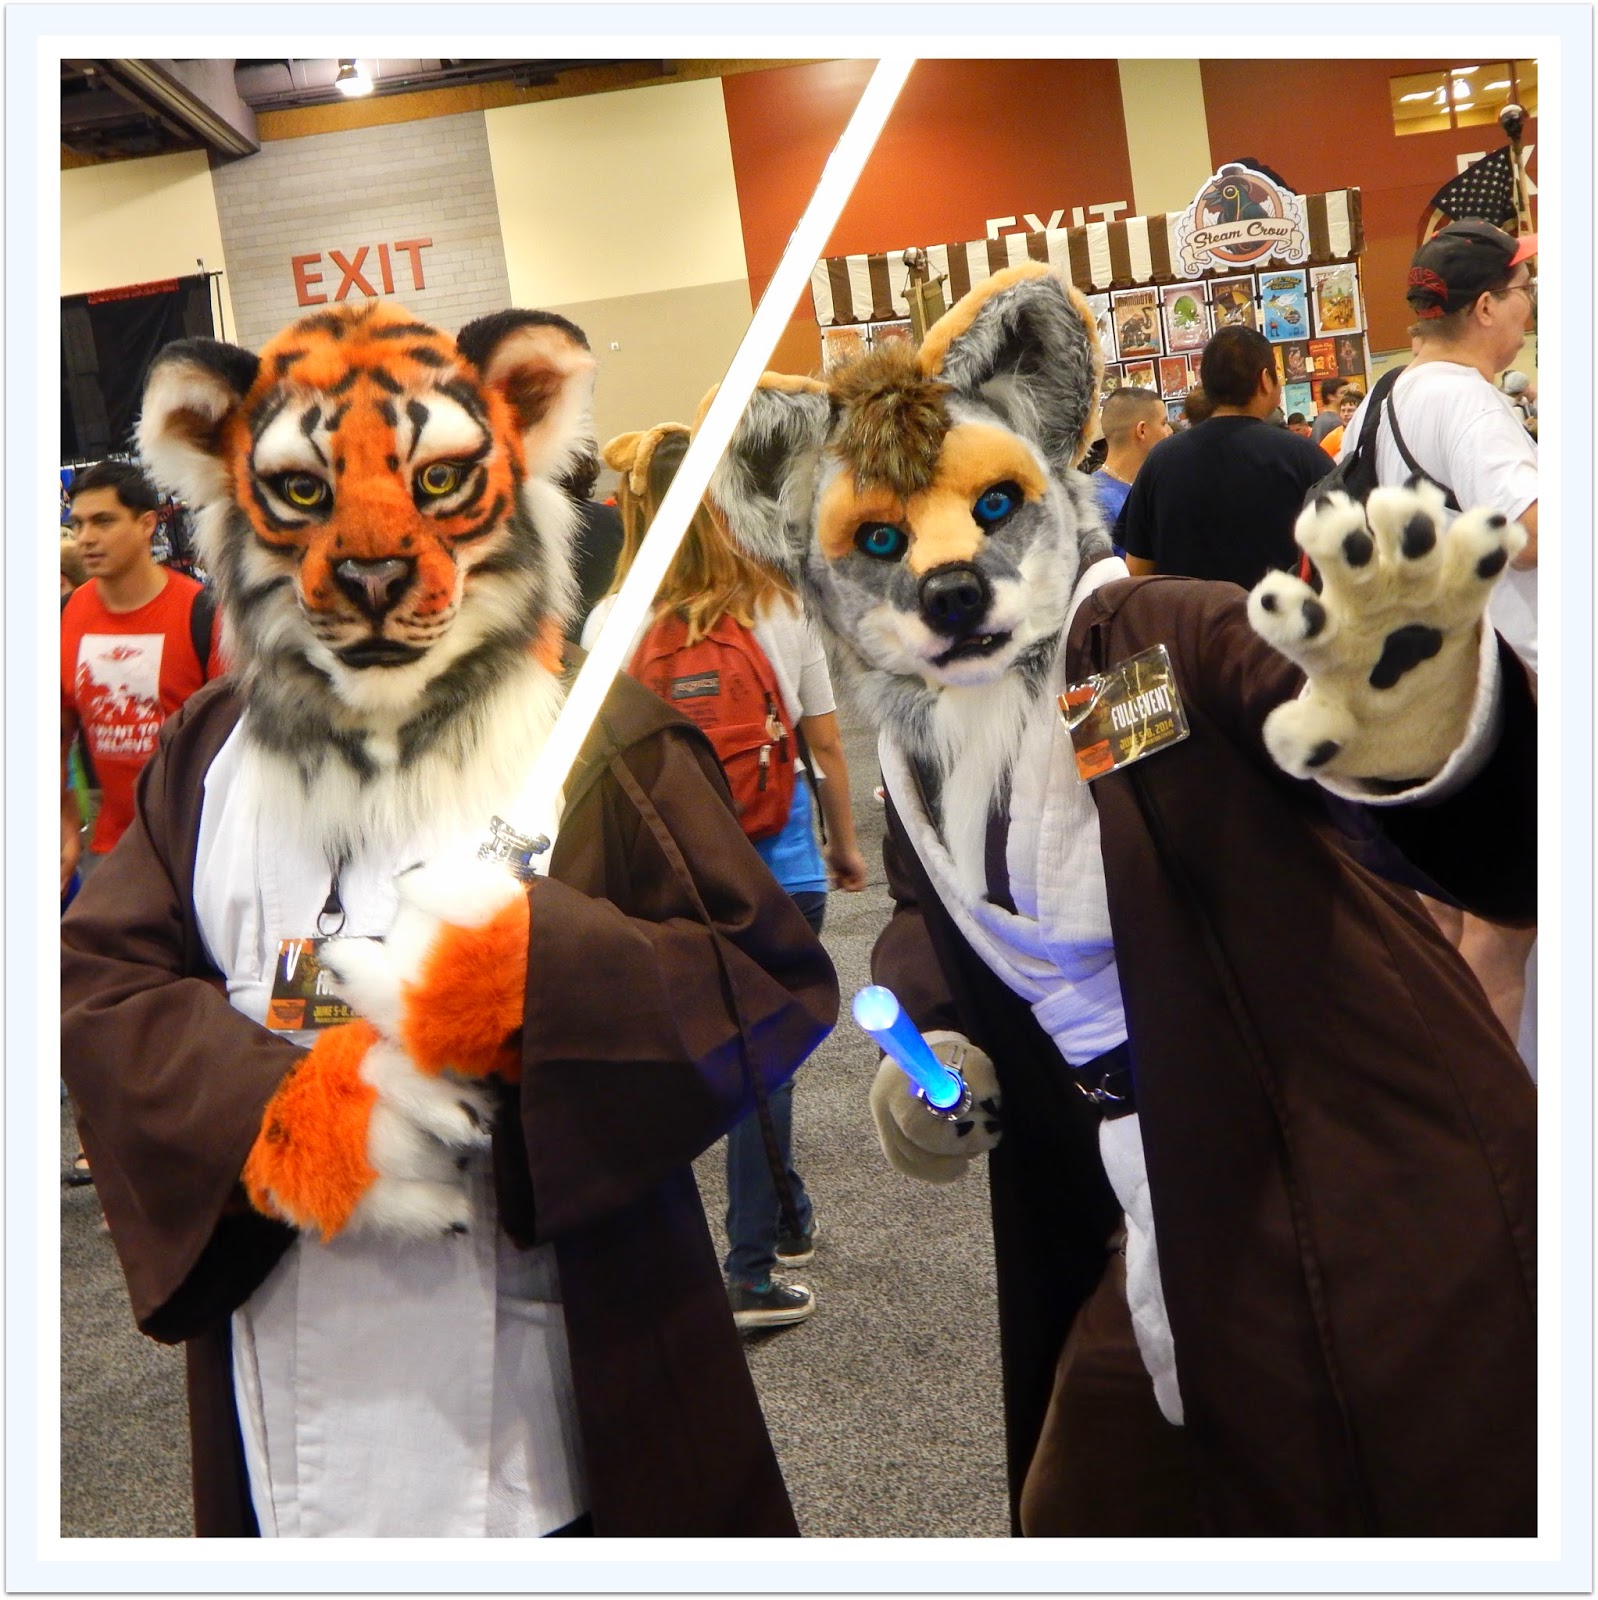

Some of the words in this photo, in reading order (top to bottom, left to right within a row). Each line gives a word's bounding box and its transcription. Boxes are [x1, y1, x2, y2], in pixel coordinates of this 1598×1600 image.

[1194, 230, 1242, 249] Steam
[1246, 221, 1288, 237] Crow
[291, 238, 433, 307] EXIT
[1111, 699, 1139, 731] FULL
[1136, 683, 1172, 719] EVENT
[138, 721, 160, 738] TO
[1155, 718, 1175, 735] 2014
